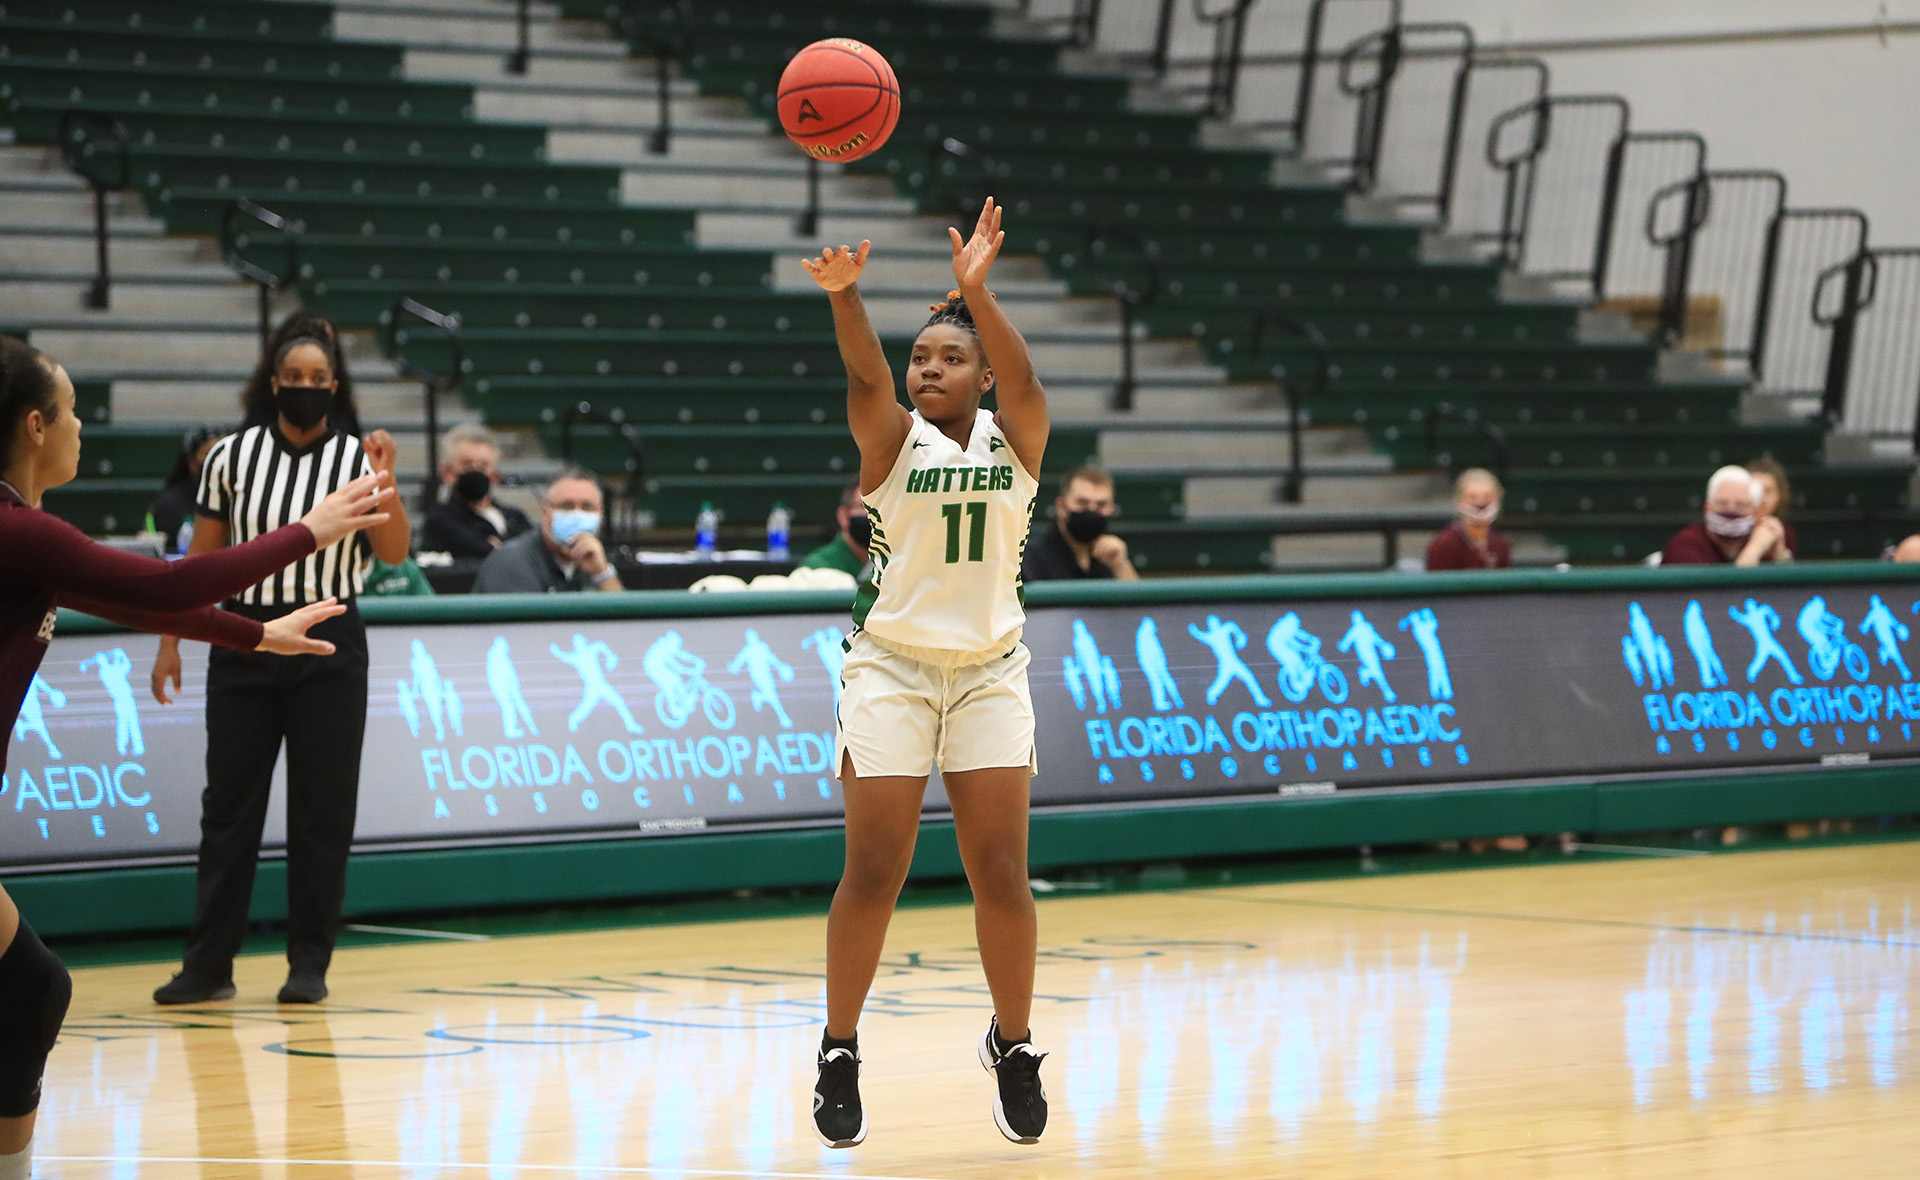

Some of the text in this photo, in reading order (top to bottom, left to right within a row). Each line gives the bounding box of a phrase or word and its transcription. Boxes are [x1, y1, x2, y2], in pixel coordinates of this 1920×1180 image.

[906, 465, 1013, 493] HATTERS
[941, 502, 987, 563] 11
[1085, 702, 1462, 759] FLORIDA ORTHOPAEDIC
[1643, 683, 1920, 731] FLORIDA ORTHOPAE
[0, 762, 152, 812] AEDIC
[421, 743, 594, 791] FLORIDA
[434, 778, 832, 818] ASSOCIATE
